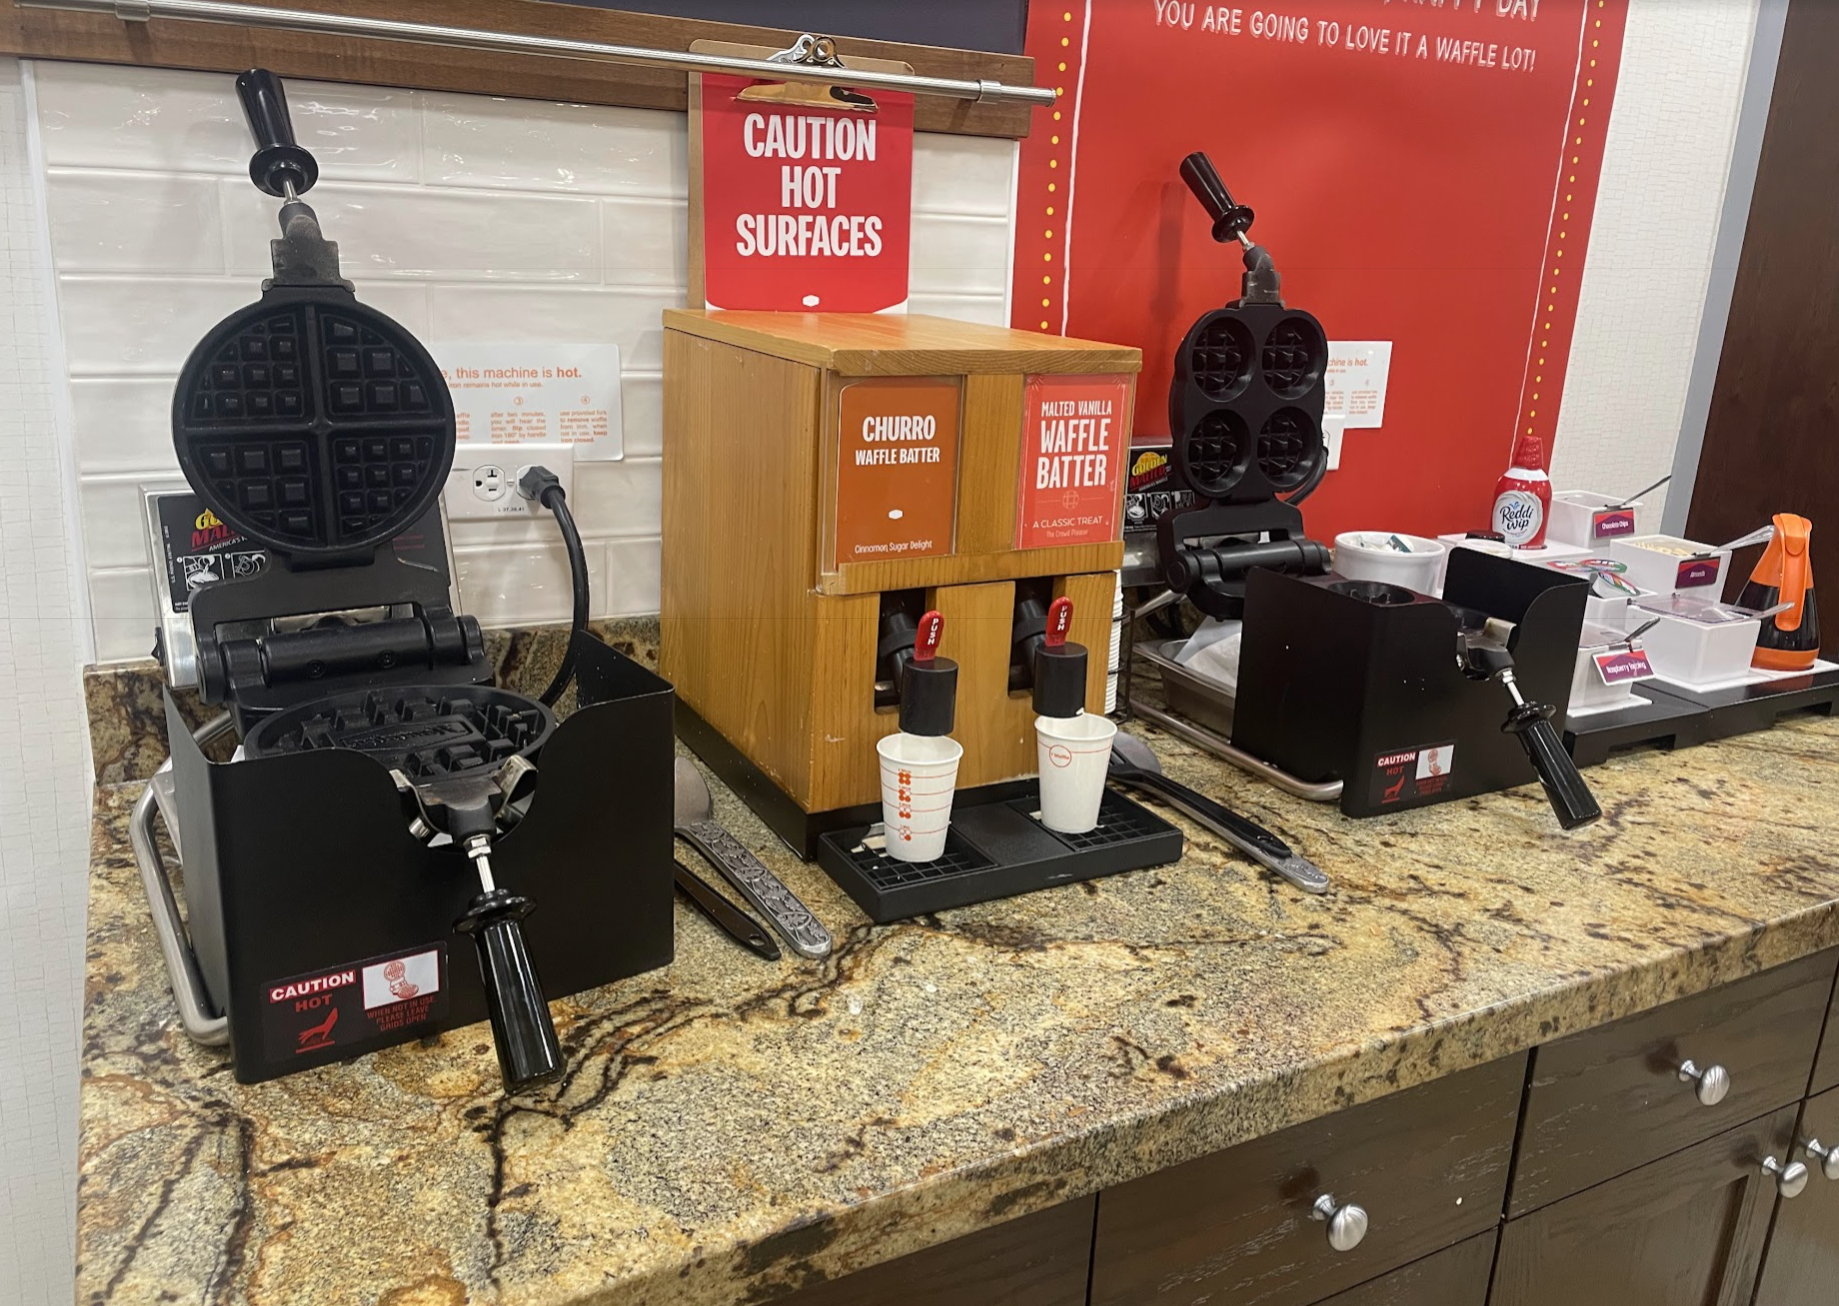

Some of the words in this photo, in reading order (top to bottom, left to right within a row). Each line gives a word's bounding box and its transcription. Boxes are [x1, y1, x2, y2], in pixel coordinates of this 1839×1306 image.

[1155, 0, 1195, 29] YOU
[1202, 6, 1242, 34] ARE
[1251, 11, 1308, 42] GOING
[1318, 21, 1339, 46] TO
[1346, 25, 1390, 53] LOVE
[1395, 32, 1411, 55] IT
[1416, 35, 1427, 58] A
[1436, 36, 1497, 66] WAFFLE
[1502, 46, 1536, 72] LOT!
[743, 113, 876, 161] CAUTION
[781, 165, 841, 208] HOT
[736, 213, 882, 257] SURFACES
[456, 367, 479, 379] this
[483, 367, 538, 379] machine
[543, 367, 552, 378] is
[557, 367, 582, 378] hot.
[1041, 401, 1075, 417] MALTED
[1078, 400, 1112, 416] VANILLA
[862, 415, 936, 442] CHURRO
[1040, 418, 1111, 454] WAFFLE
[855, 449, 897, 466] WAFFLE
[900, 447, 940, 464] BATTER
[1131, 454, 1168, 477] GOLDEN
[1036, 454, 1107, 490] BATTER
[1033, 521, 1039, 529] A
[1040, 517, 1075, 528] CLASSIC
[1077, 515, 1103, 526] TREAT
[1500, 505, 1534, 524] Reddi
[1506, 518, 1529, 531] wip
[889, 541, 909, 553] Sugar
[910, 540, 933, 551] Delight
[1058, 605, 1068, 631] PUSH
[927, 618, 939, 646] PUSH
[1377, 752, 1417, 767] CAUTION
[1386, 766, 1404, 776] HOT
[271, 971, 354, 1001] CAUTION
[295, 993, 333, 1013] HOT
[366, 1007, 390, 1019] WHEN
[391, 1003, 408, 1014] NOT
[409, 1000, 420, 1010] IN
[420, 995, 435, 1006] USE
[376, 1012, 406, 1025] PLEASE
[406, 1006, 430, 1018] LEAVE
[380, 1019, 404, 1032] GRIDS
[406, 1014, 427, 1026] OPEN
